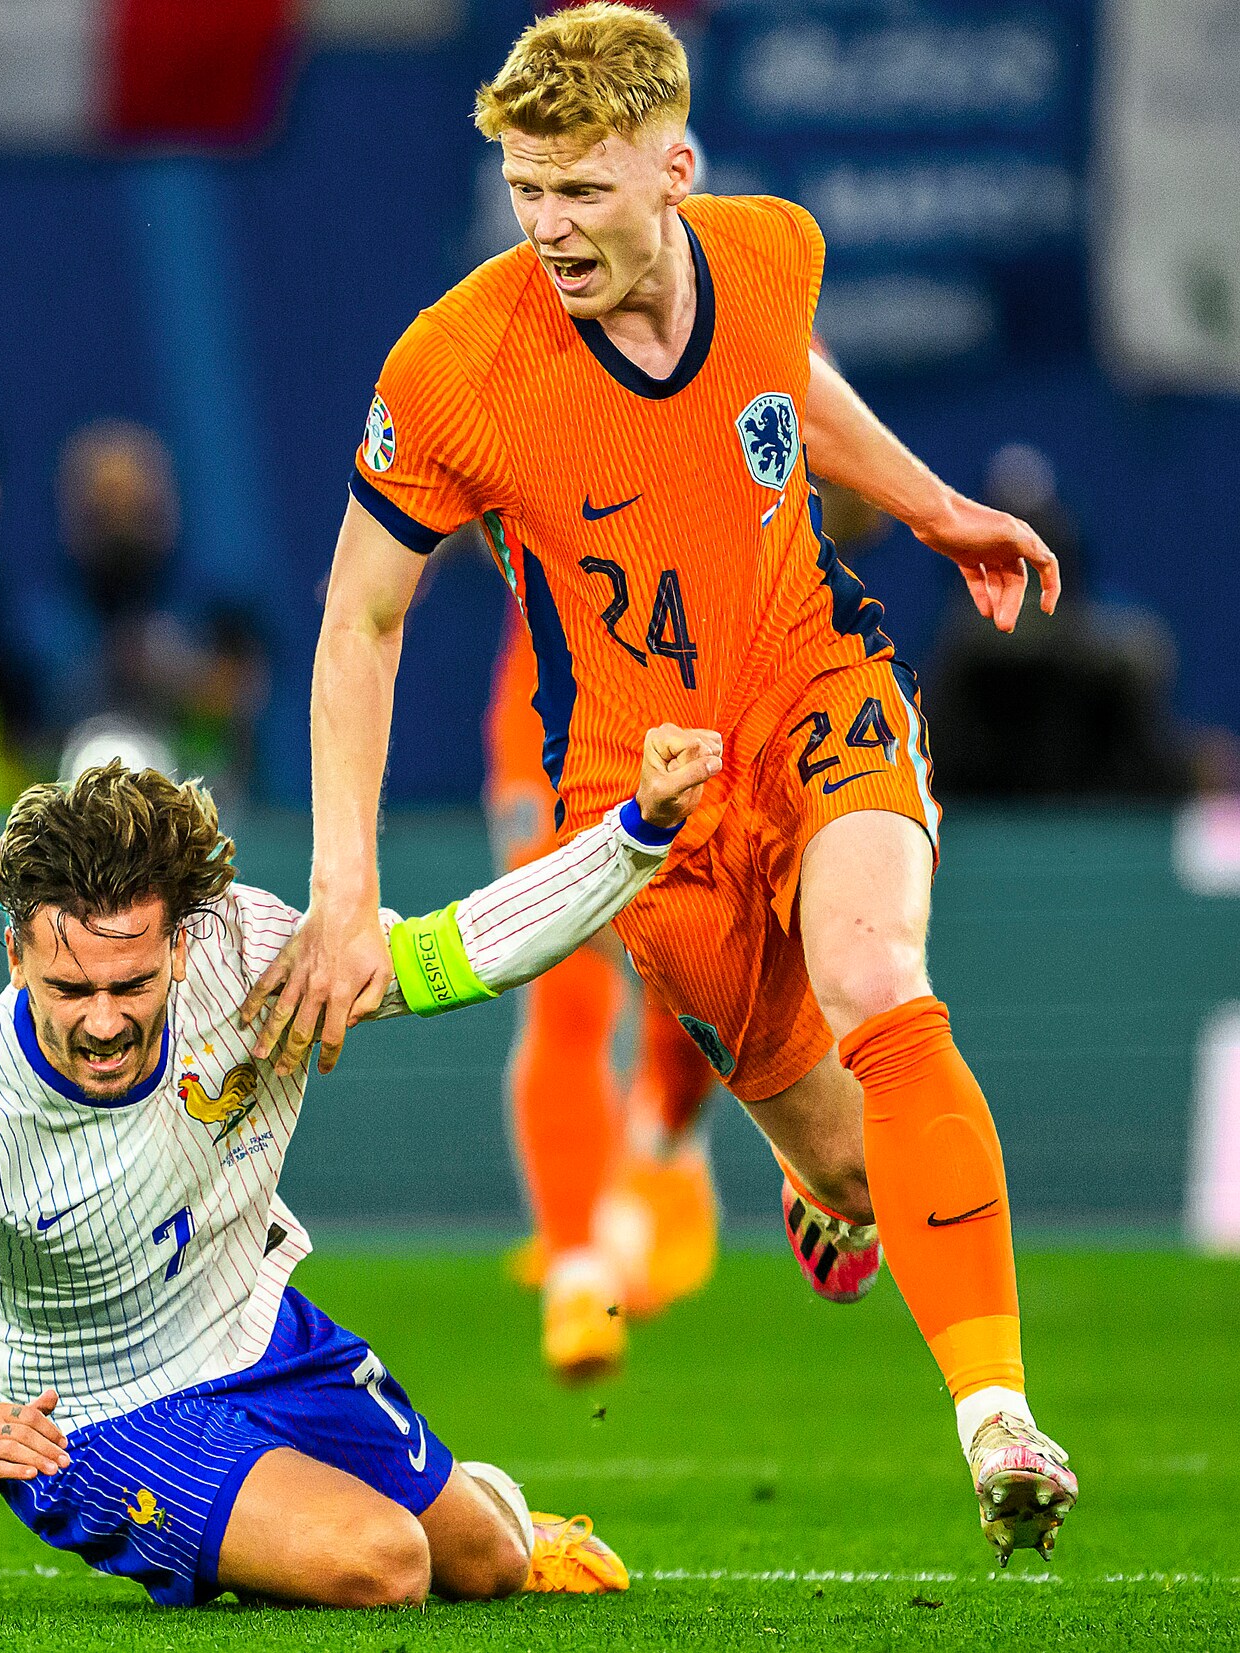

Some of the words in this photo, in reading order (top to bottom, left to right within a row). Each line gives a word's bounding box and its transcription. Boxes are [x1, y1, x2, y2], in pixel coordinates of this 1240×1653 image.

[578, 555, 698, 690] 24
[787, 697, 900, 788] 24
[419, 932, 452, 1001] RESPECT
[152, 1205, 196, 1283] 7
[351, 1348, 411, 1436] 7
